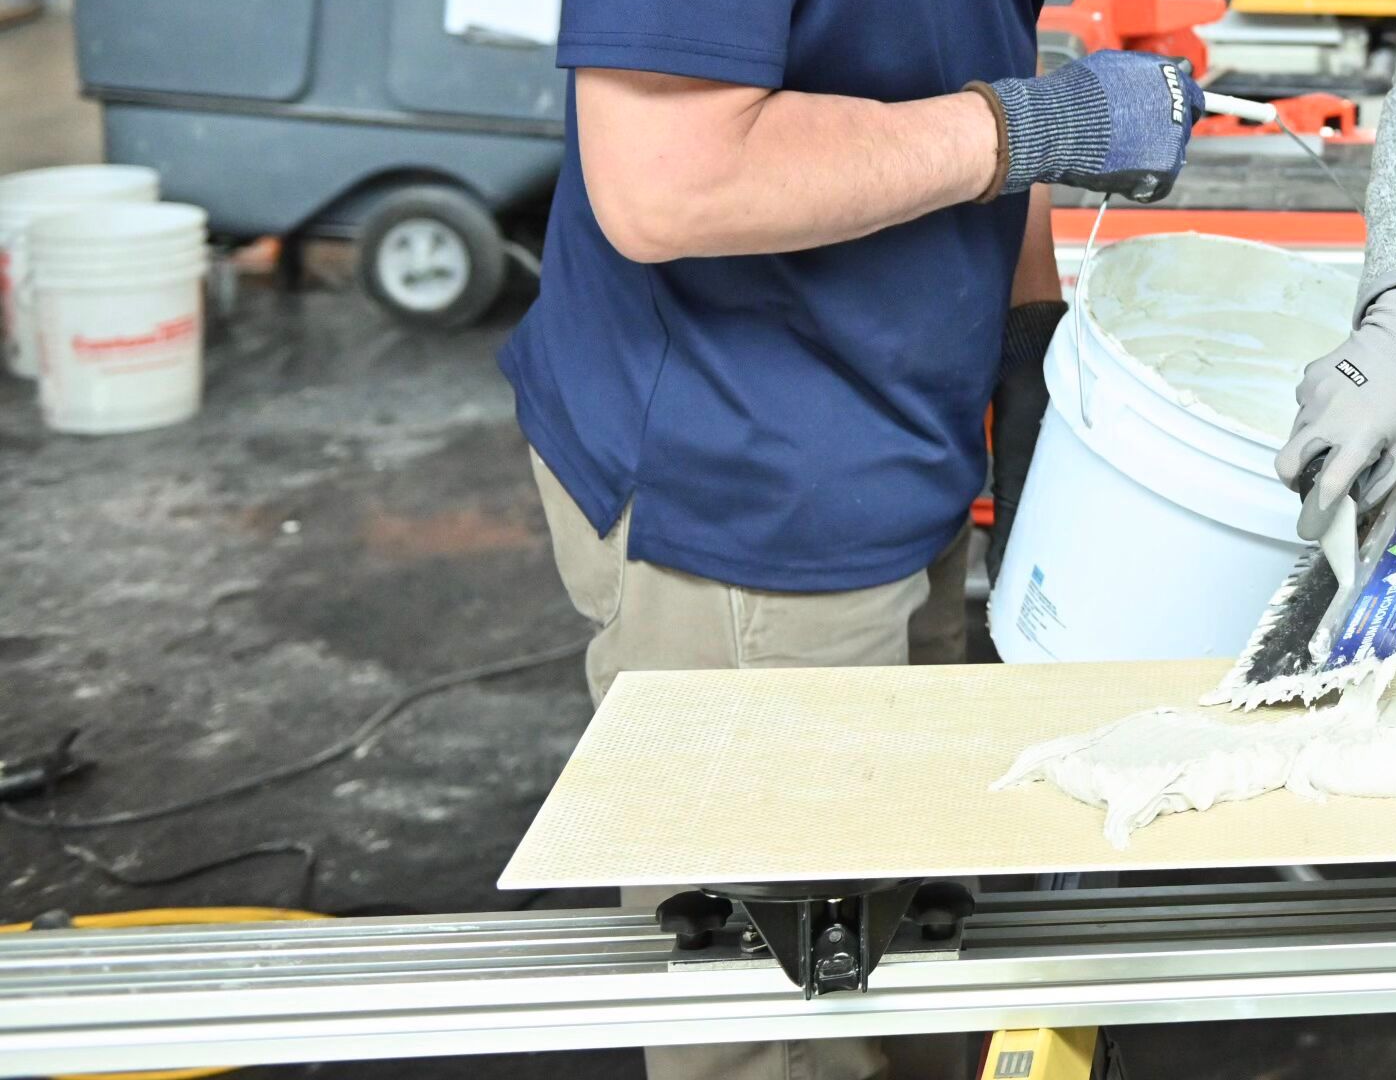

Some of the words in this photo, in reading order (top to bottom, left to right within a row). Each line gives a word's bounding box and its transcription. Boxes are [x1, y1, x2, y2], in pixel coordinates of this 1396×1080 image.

[1163, 65, 1184, 123] ULINE
[1337, 360, 1366, 386] ULINE
[1350, 624, 1380, 663] PMIUM
[1369, 594, 1396, 625] NOTCH
